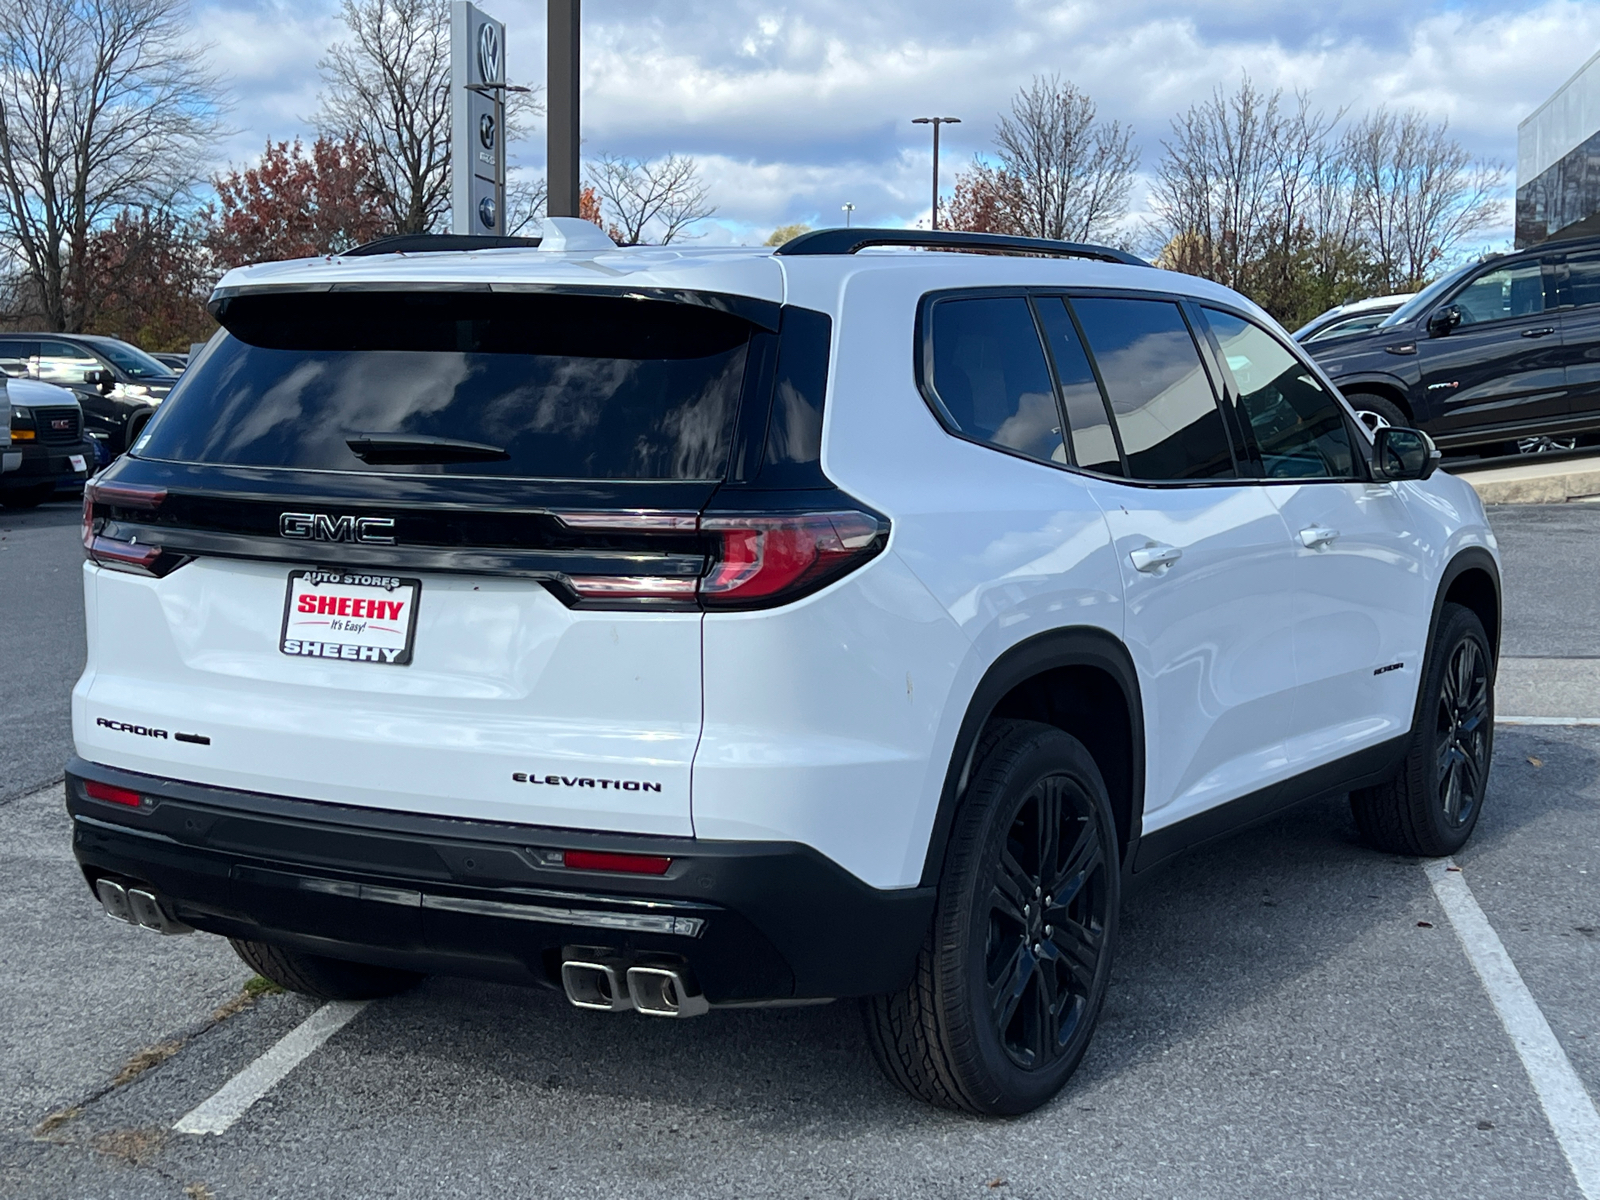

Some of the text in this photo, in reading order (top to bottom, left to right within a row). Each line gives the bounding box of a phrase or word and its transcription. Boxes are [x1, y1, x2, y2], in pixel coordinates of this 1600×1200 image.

[279, 512, 396, 545] GMC
[302, 571, 400, 588] AUTO STORES
[297, 594, 404, 621] SHEEHY
[330, 619, 367, 634] It's Easy!
[283, 640, 402, 663] SHEEHY
[96, 717, 168, 740] ACADIA
[512, 772, 662, 792] ELEVATION
